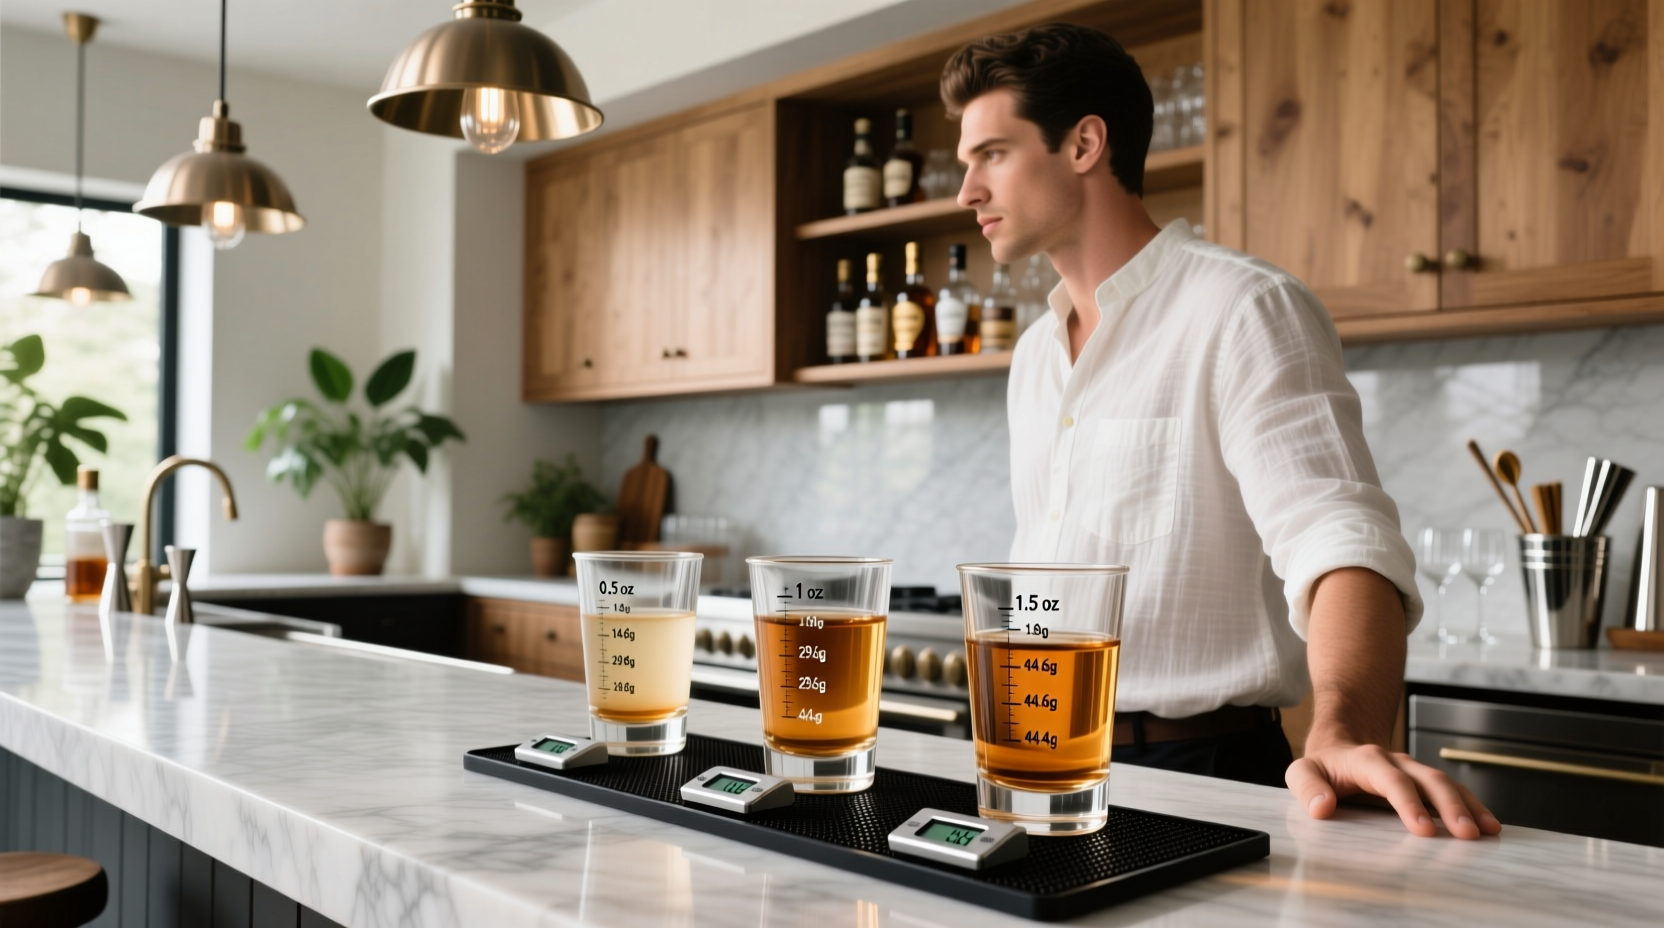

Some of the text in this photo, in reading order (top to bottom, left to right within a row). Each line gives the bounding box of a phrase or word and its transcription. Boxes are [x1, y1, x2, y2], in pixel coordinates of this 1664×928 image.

[599, 580, 634, 595] 0.5 oz
[796, 582, 824, 599] 1 oz
[1016, 594, 1060, 611] 1.5 oz
